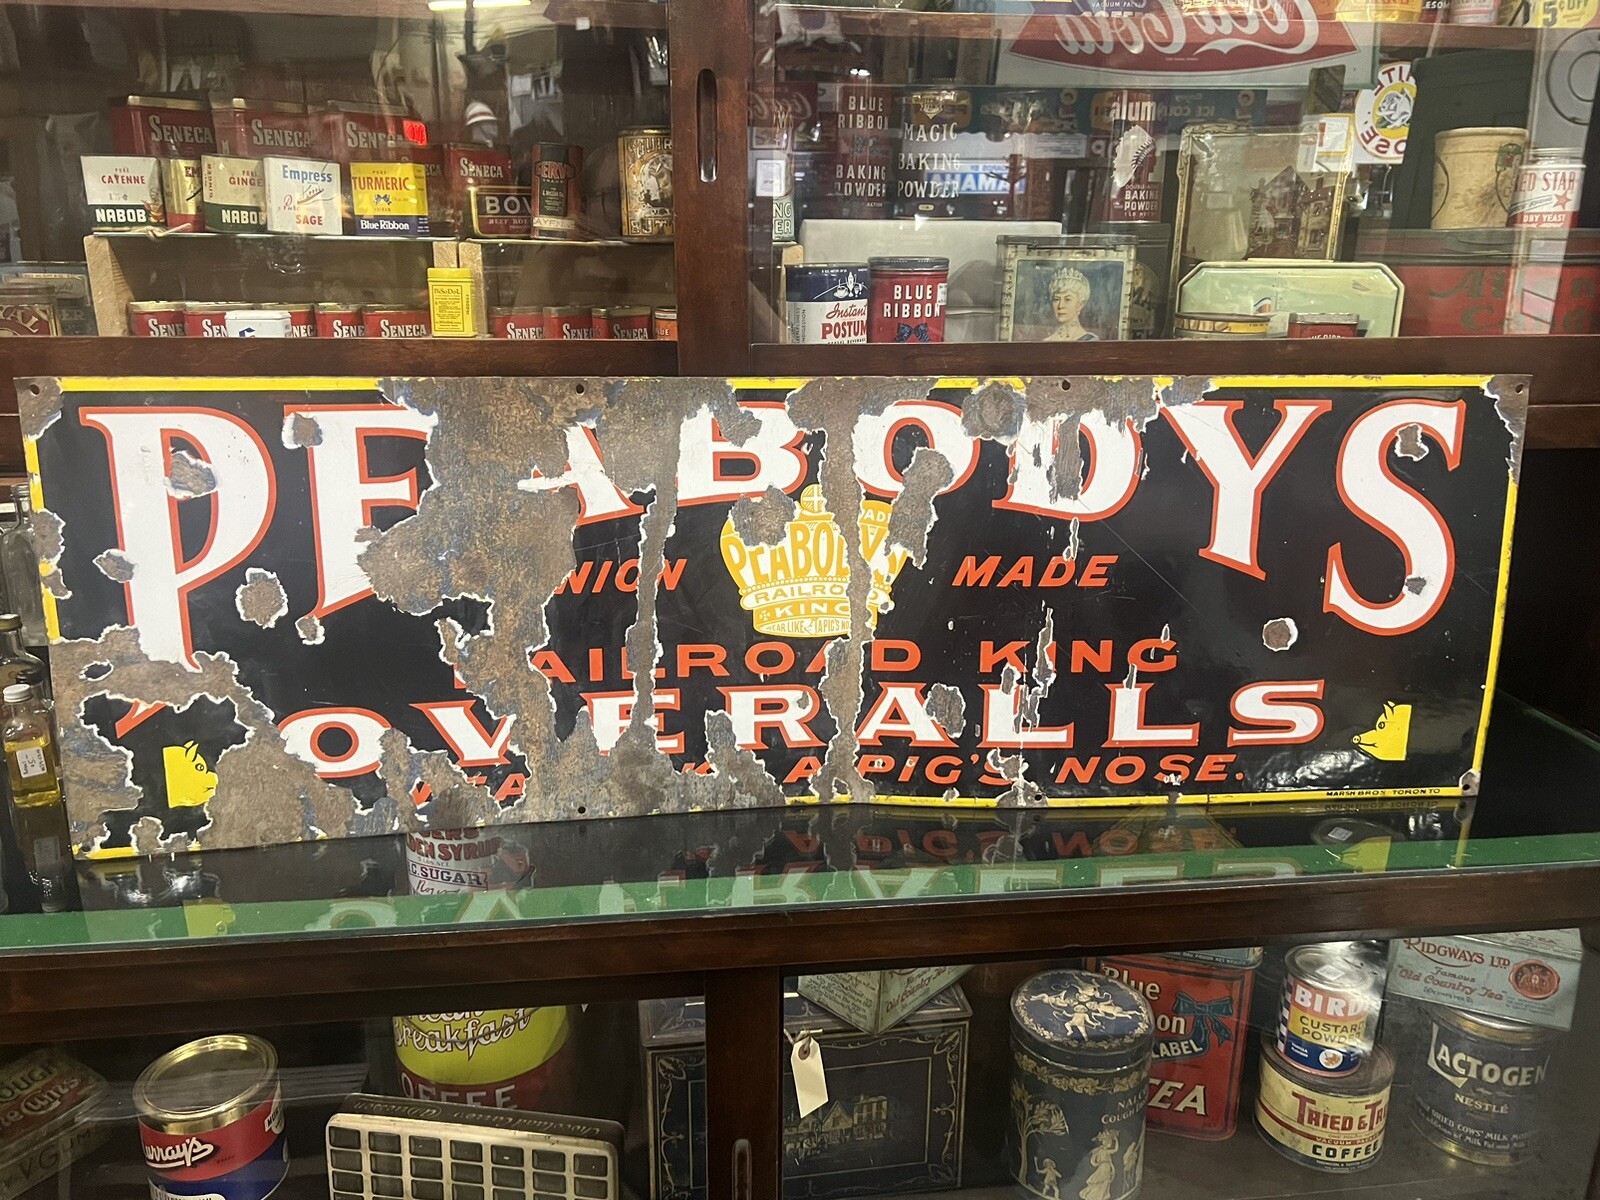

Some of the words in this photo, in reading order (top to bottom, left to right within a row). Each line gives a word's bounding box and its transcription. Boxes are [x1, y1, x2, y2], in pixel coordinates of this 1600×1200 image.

[848, 95, 884, 112] BLUE
[150, 115, 213, 143] SENECA
[252, 118, 311, 147] SENECA
[904, 121, 958, 142] MAGIC
[460, 157, 503, 178] SENECA
[898, 152, 960, 171] BAKING
[102, 175, 145, 185] CAYENNE
[229, 176, 263, 187] GINGE
[282, 164, 333, 184] Empress
[836, 164, 887, 180] BAKING
[1541, 170, 1577, 192] STAR
[352, 176, 411, 191] TURMERIC
[897, 180, 959, 199] POWDER
[95, 208, 147, 223] NABOB
[295, 214, 323, 226] SAGE
[360, 219, 379, 230] Blue
[379, 219, 410, 230] Ribbon
[534, 218, 575, 230] AYENNE
[1523, 212, 1539, 223] DRY
[1542, 212, 1566, 222] YEAST
[894, 285, 933, 300] BLUE
[826, 302, 868, 320] Instant
[883, 302, 941, 318] RIBBON
[202, 318, 228, 338] SEN
[333, 319, 365, 338] SENE
[380, 319, 427, 338] SENECA
[614, 324, 648, 339] SENECA
[555, 559, 687, 595] NION
[953, 554, 1120, 588] MADE
[766, 622, 786, 632] WEAR
[787, 621, 805, 633] LIKE
[978, 638, 1177, 673] KING
[278, 679, 1326, 779] OVERALLS
[858, 754, 1016, 784] PIG'S
[1326, 788, 1356, 796] MARSH
[420, 867, 483, 886] SUGAR
[1403, 937, 1485, 966] RIDGWAYS
[1432, 966, 1476, 983] Famous
[1424, 976, 1476, 997] Country
[1299, 1015, 1366, 1035] CUSTARD
[1427, 1022, 1551, 1089] LACTOGEN
[1291, 1090, 1354, 1132] TRIED
[1357, 1114, 1368, 1131] &
[1454, 1092, 1510, 1114] NESTLÉ
[1312, 1139, 1379, 1159] COFFEE
[1316, 1136, 1352, 1145] VACUUM
